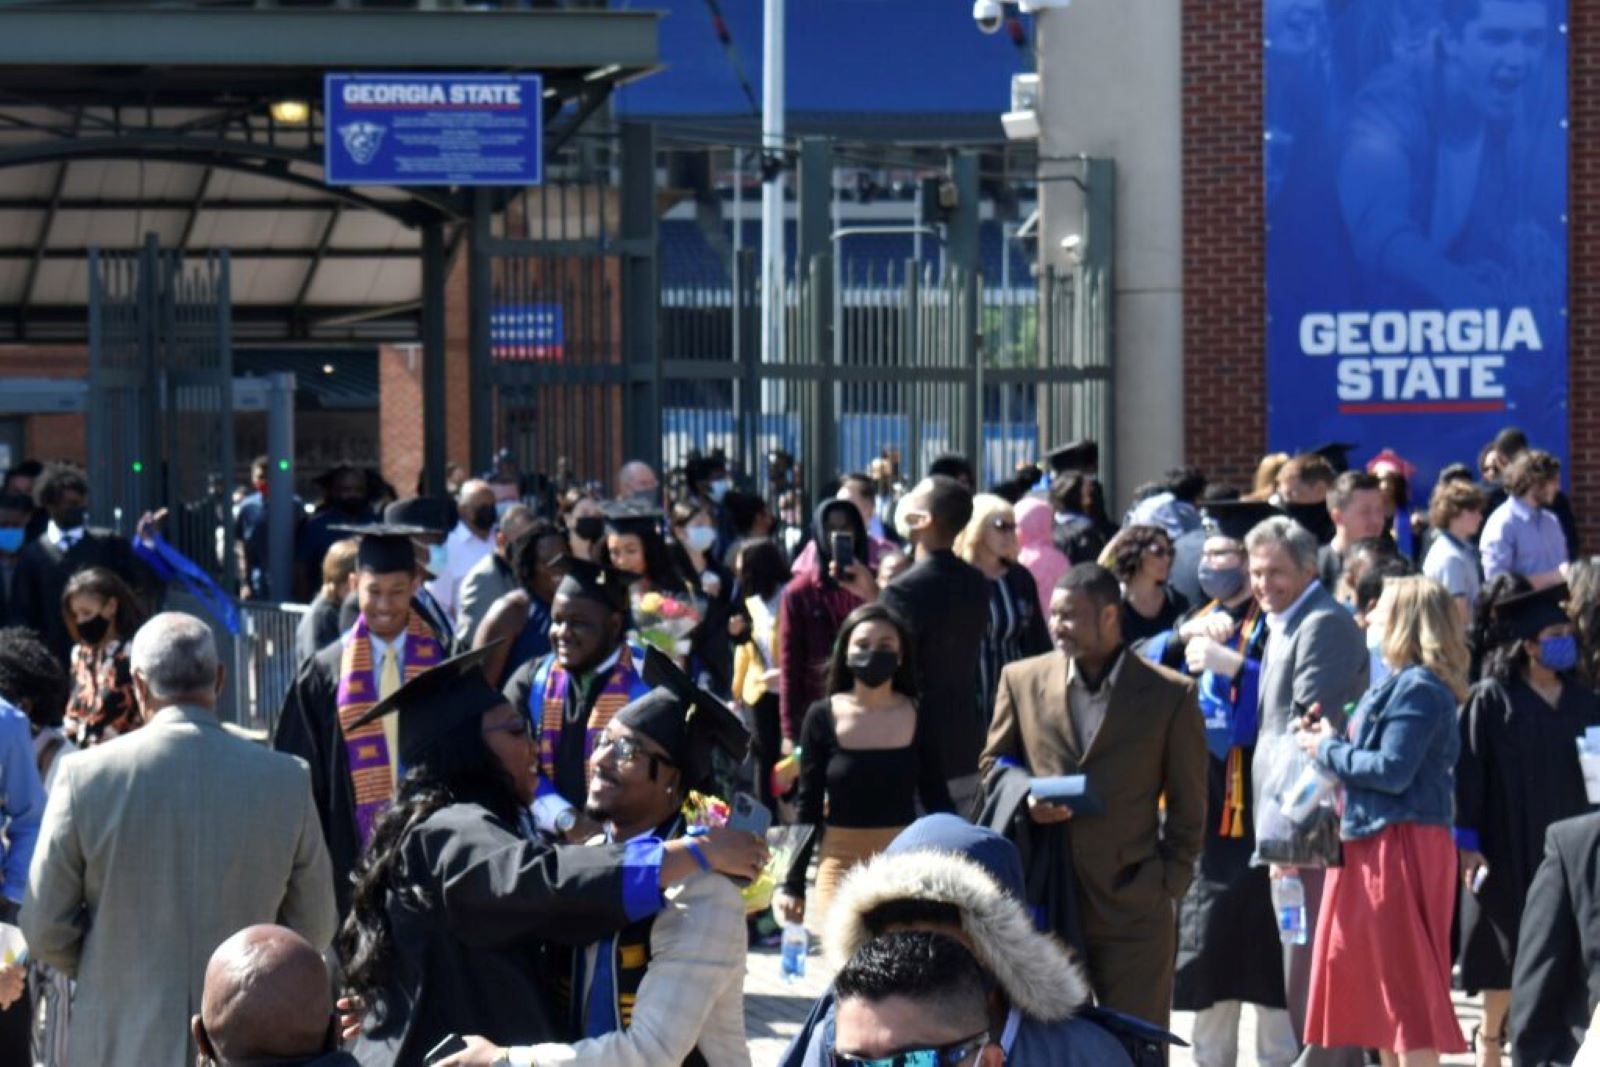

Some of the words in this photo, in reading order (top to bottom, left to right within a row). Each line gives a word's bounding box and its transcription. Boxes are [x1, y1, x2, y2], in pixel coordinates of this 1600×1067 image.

[343, 84, 446, 103] GEORGIA
[450, 84, 521, 103] STATE
[1300, 307, 1542, 355] GEORGIA
[1337, 356, 1505, 400] STATE
